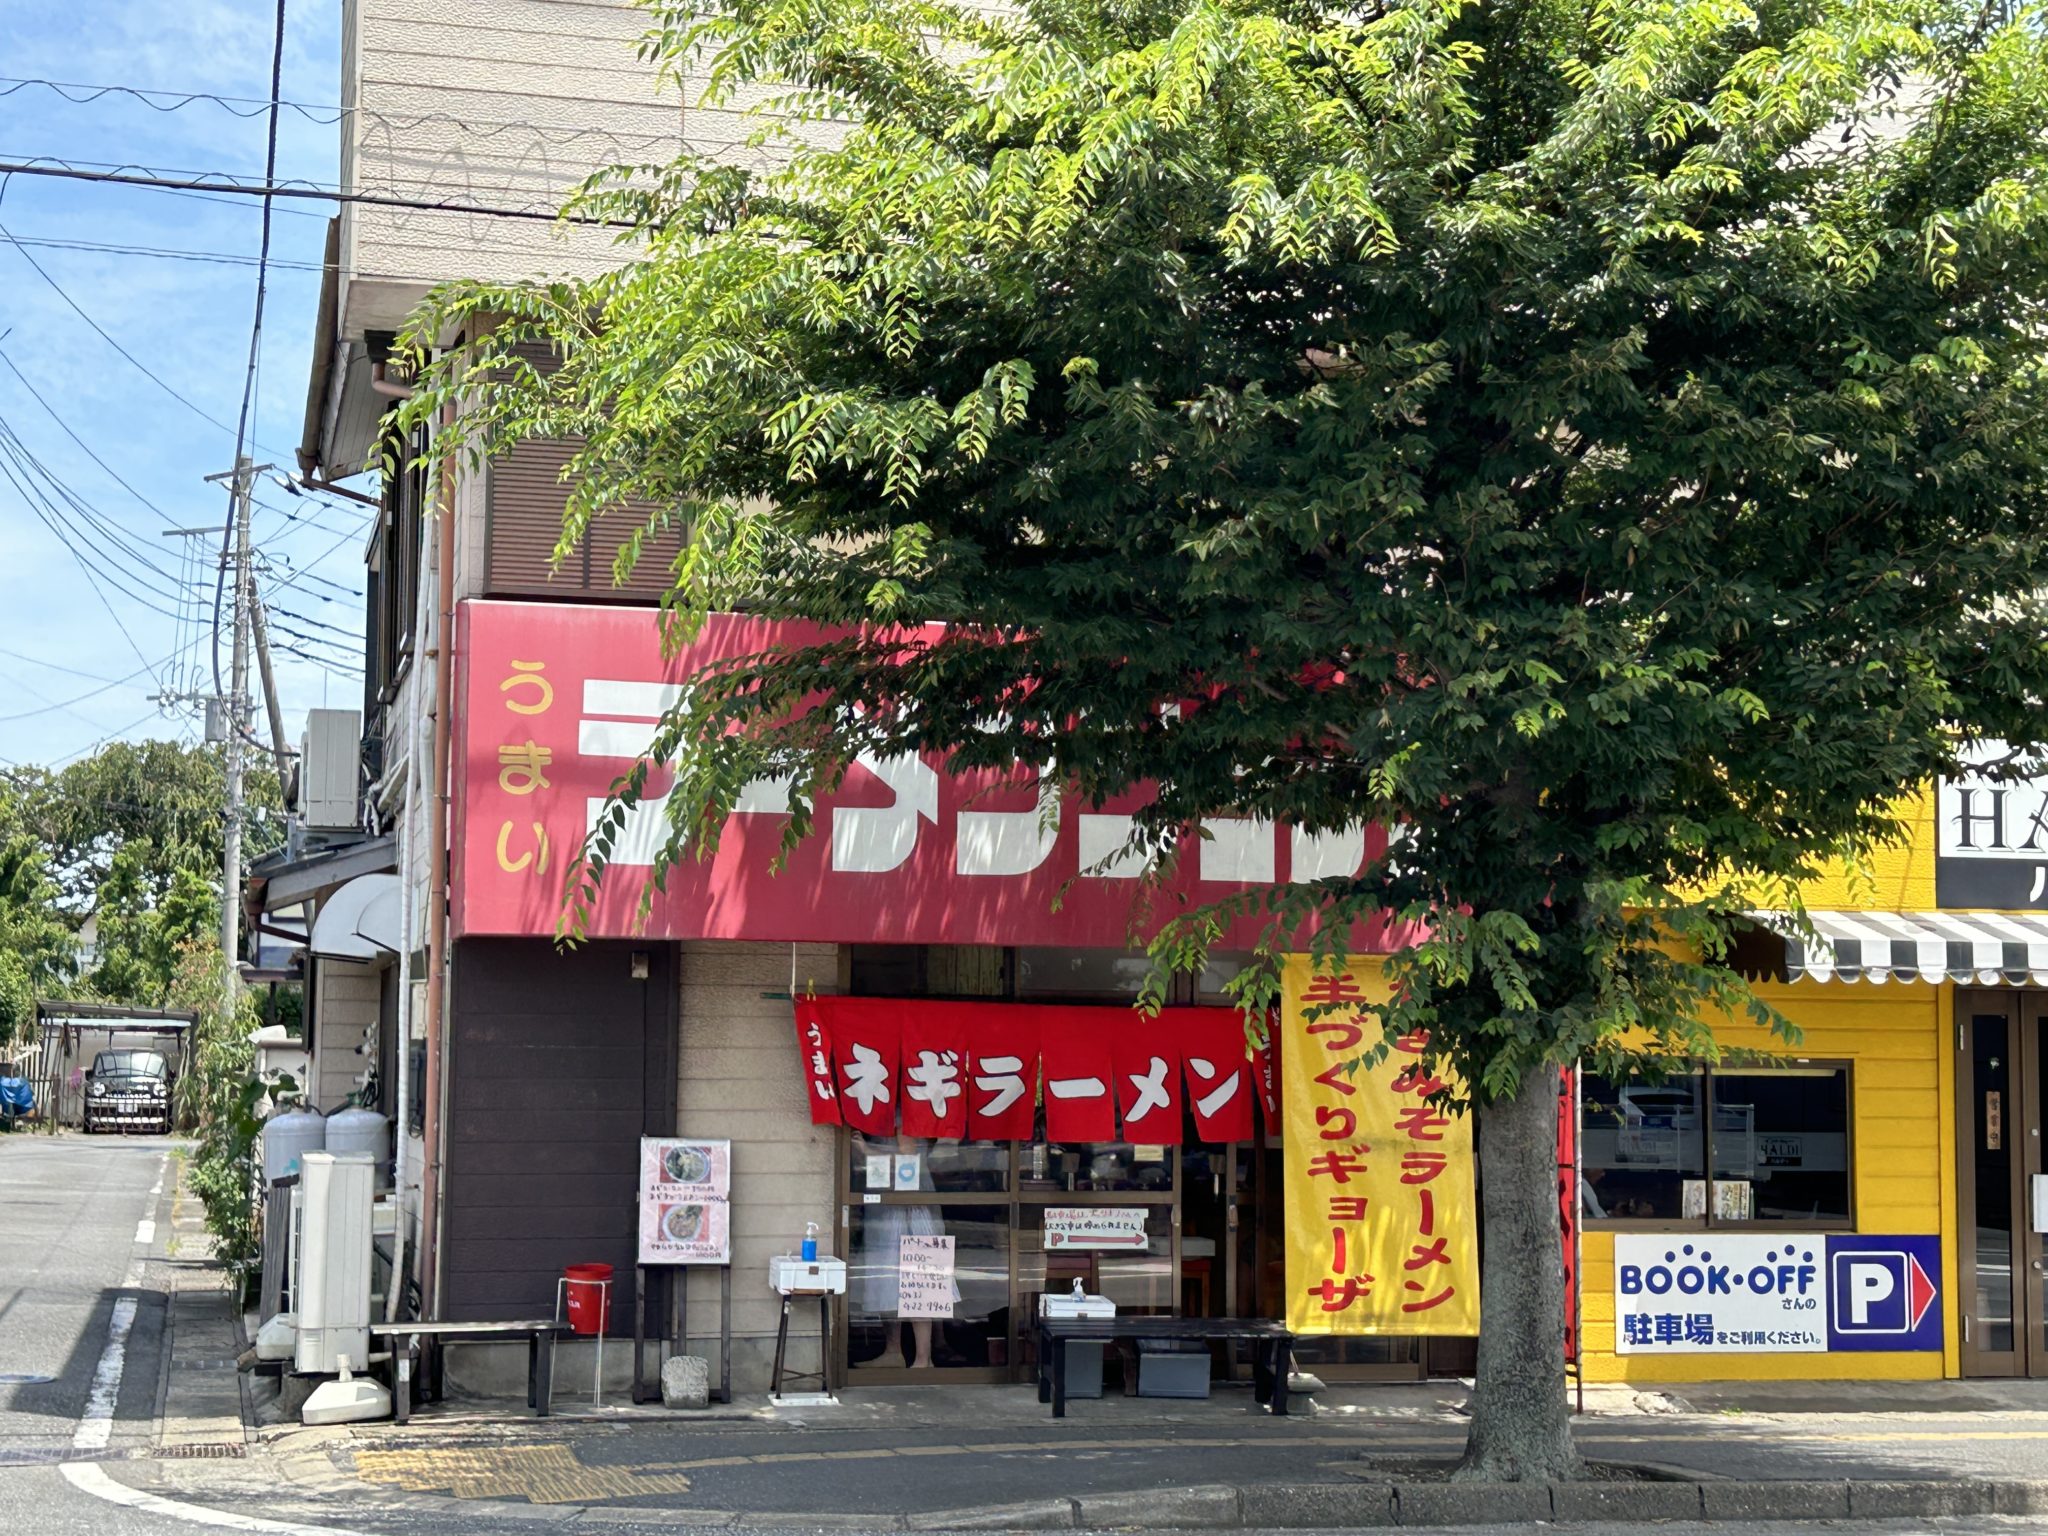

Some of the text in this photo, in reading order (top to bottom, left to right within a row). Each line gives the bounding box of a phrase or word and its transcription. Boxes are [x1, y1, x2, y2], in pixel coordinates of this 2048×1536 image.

[496, 659, 554, 876] うまい
[807, 1021, 835, 1101] うまい
[842, 1041, 1240, 1123] ネギラーメン
[1388, 979, 1456, 1314] みそラーメン
[1051, 1232, 1064, 1247] P
[1781, 1297, 1817, 1311] さんの
[1850, 1262, 1895, 1324] P
